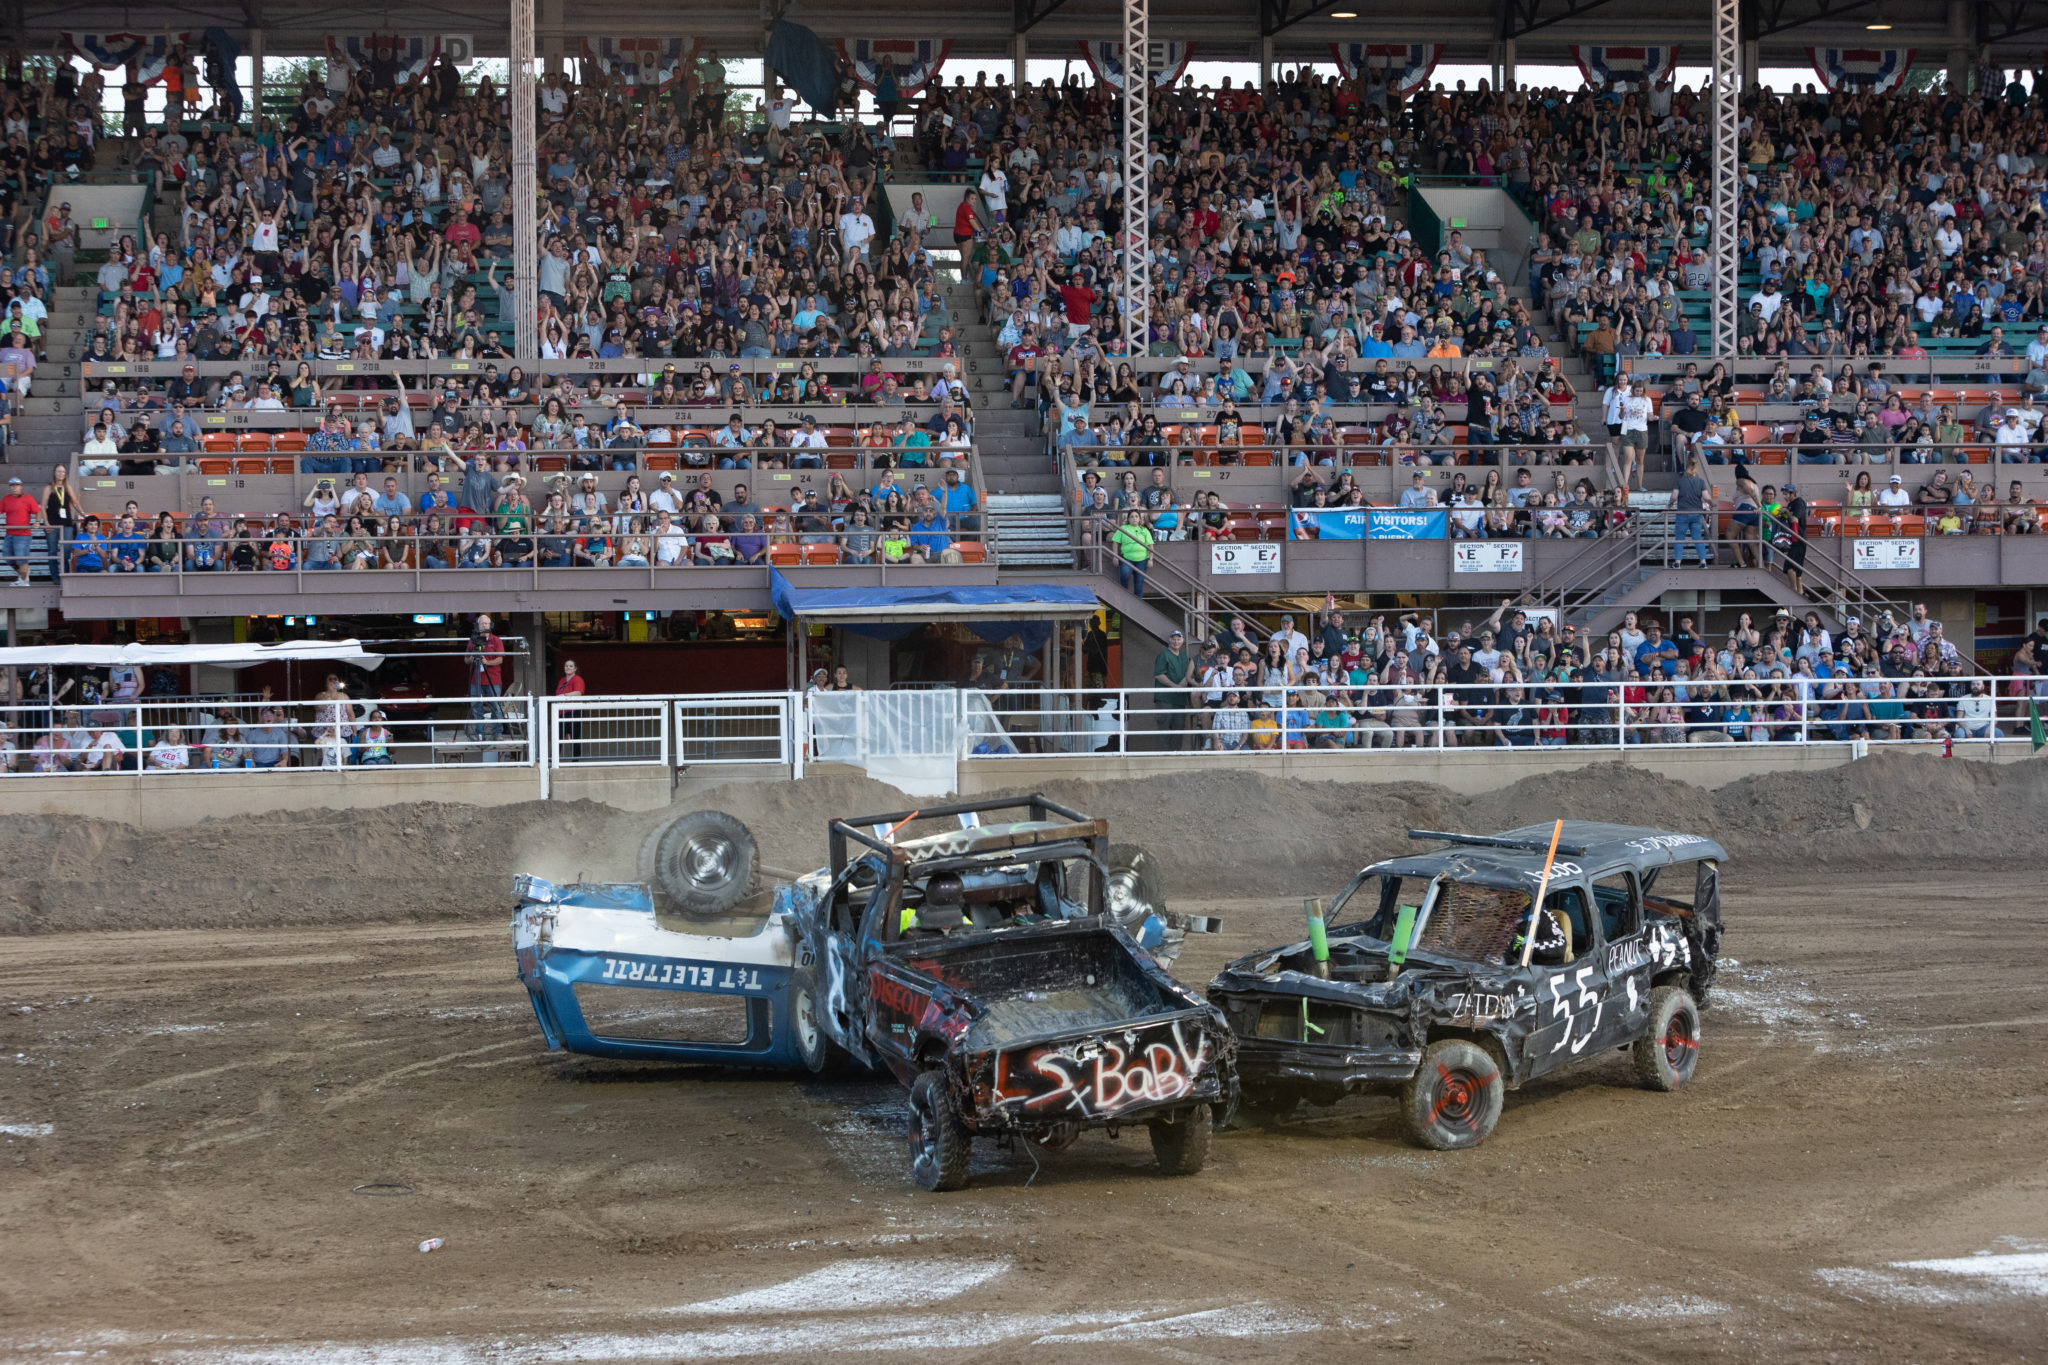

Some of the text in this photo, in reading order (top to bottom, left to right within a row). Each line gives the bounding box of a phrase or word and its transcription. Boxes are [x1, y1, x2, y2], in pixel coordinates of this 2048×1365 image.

[446, 38, 468, 61] D
[81, 290, 88, 300] 9
[947, 287, 953, 296] 9
[68, 349, 76, 360] 6
[964, 345, 971, 356] 6
[970, 361, 977, 372] 5
[64, 367, 71, 377] 5
[975, 377, 983, 388] 4
[57, 383, 65, 393] 4
[981, 396, 988, 406] 3
[53, 402, 60, 412] 3
[800, 474, 811, 483] 24
[913, 474, 925, 482] 25
[1219, 472, 1231, 480] 27
[1838, 470, 1849, 478] 32
[686, 475, 697, 484] 23
[1373, 516, 1427, 525] VISITORS!
[1225, 551, 1235, 561] D
[1259, 550, 1267, 560] E
[1467, 549, 1476, 560] E
[1501, 549, 1509, 559] F
[1866, 546, 1875, 557] E
[1899, 546, 1907, 556] F
[1608, 937, 1644, 976] PEANUT
[602, 958, 762, 990] T&T ELECTRIC
[1550, 966, 1603, 1054] 55
